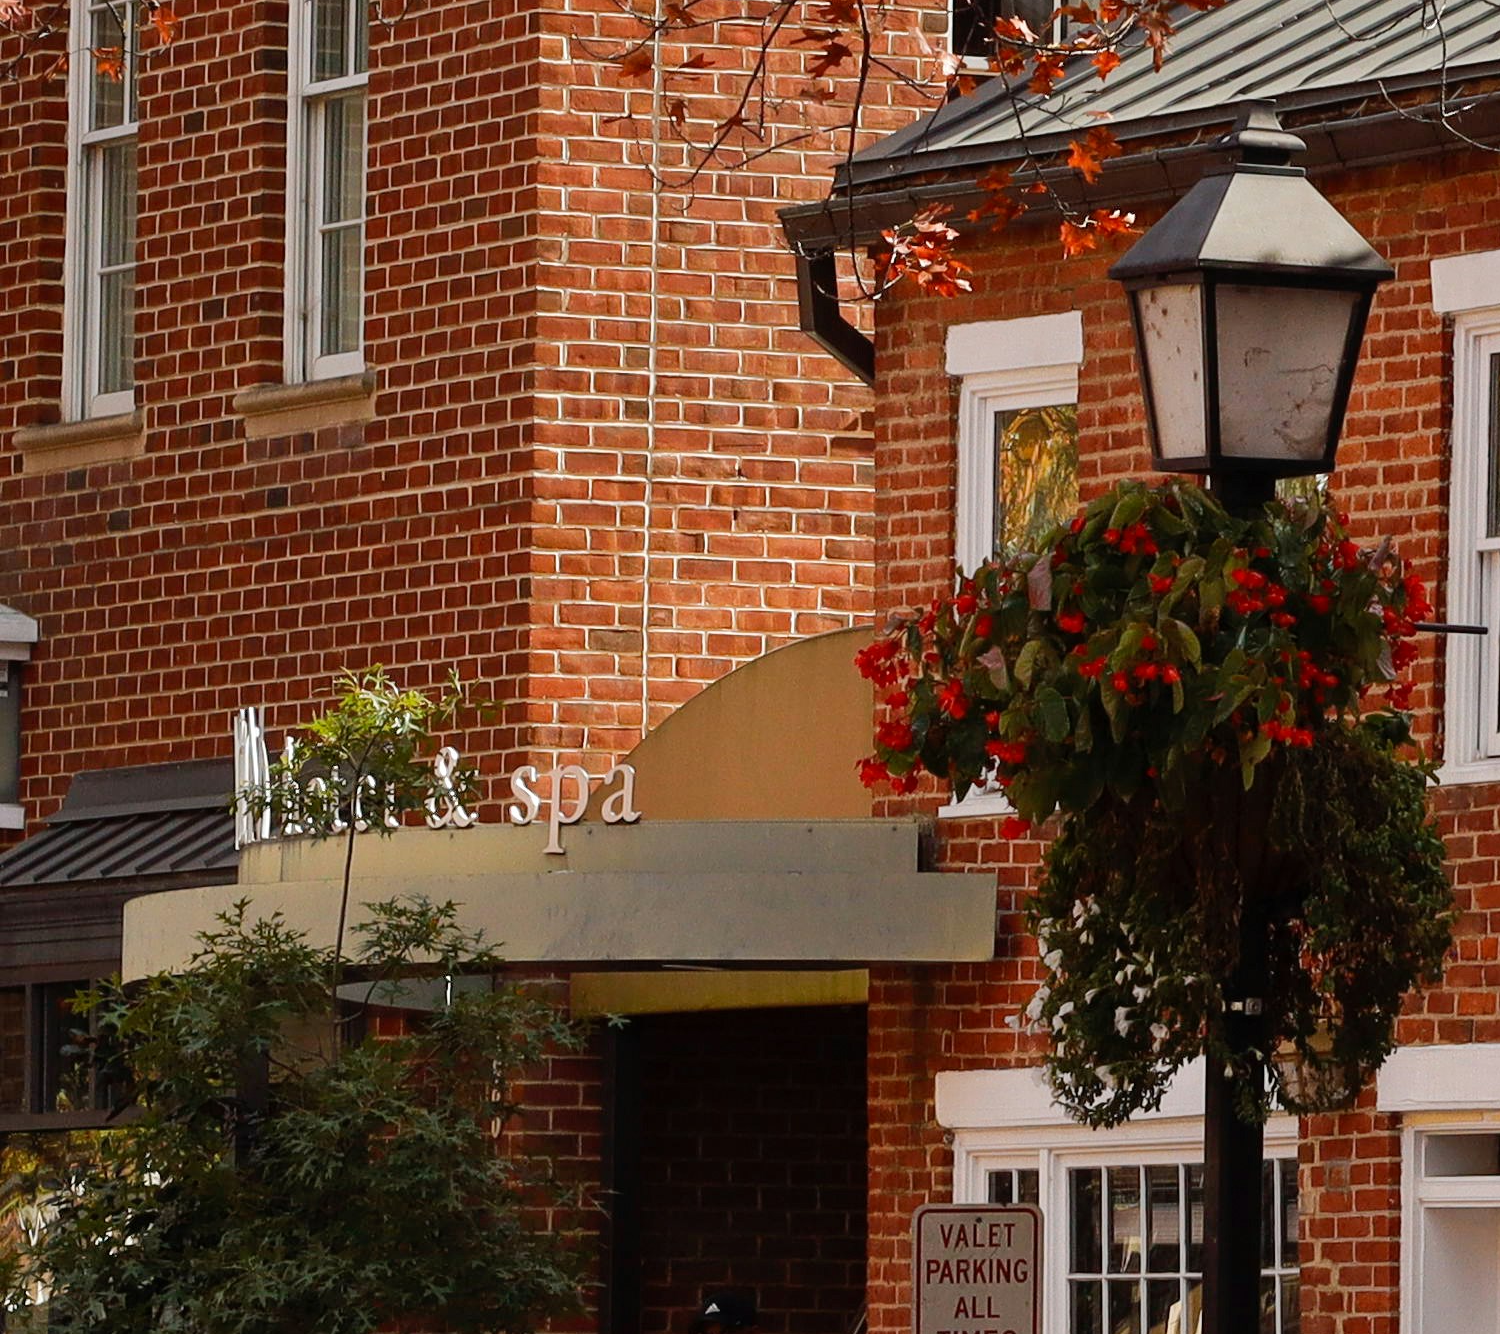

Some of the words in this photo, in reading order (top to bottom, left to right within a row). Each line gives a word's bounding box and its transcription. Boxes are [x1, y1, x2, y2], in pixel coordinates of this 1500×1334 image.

[509, 763, 642, 855] spa
[940, 1223, 1016, 1248] VALET
[926, 1258, 1029, 1284] PARKING
[954, 1296, 1001, 1318] ALL
